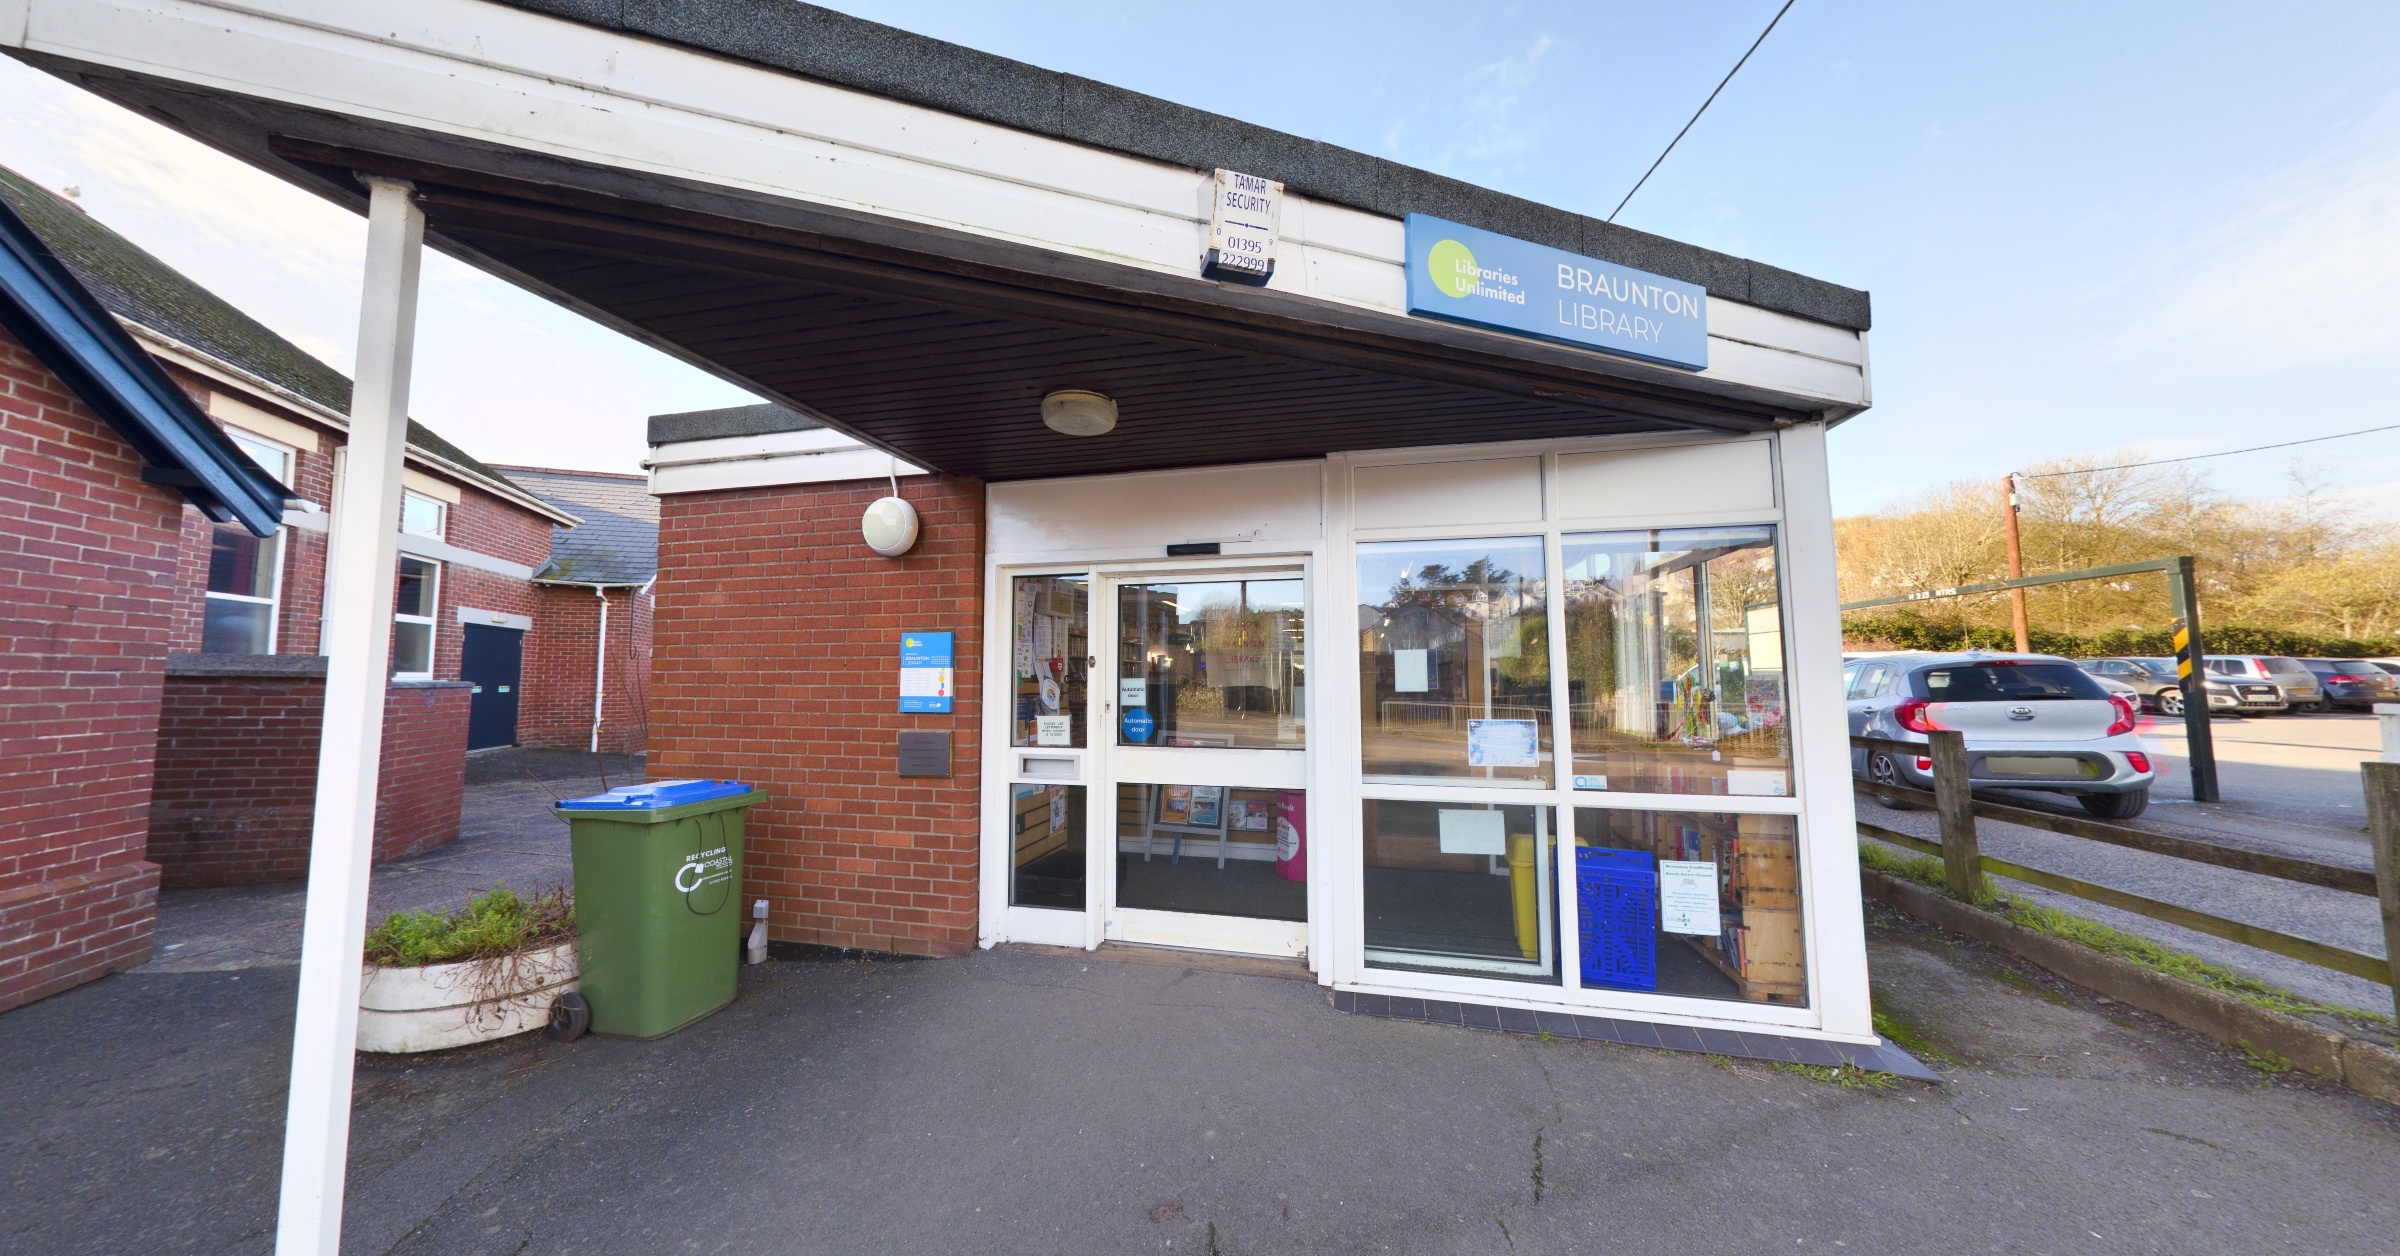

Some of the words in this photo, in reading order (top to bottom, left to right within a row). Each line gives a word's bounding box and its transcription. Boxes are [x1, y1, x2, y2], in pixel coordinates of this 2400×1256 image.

[1234, 173, 1267, 195] TAMAR
[1226, 191, 1271, 214] SECURITY
[1227, 236, 1262, 254] 01395
[1221, 252, 1265, 271] 222999
[1455, 258, 1518, 286] Libraries
[1455, 276, 1525, 305] Unlimited
[1557, 263, 1699, 320] BRAUNTON
[1558, 299, 1664, 344] LIBRARY
[686, 846, 726, 862] RECYCLING
[704, 855, 733, 868] COASTL
